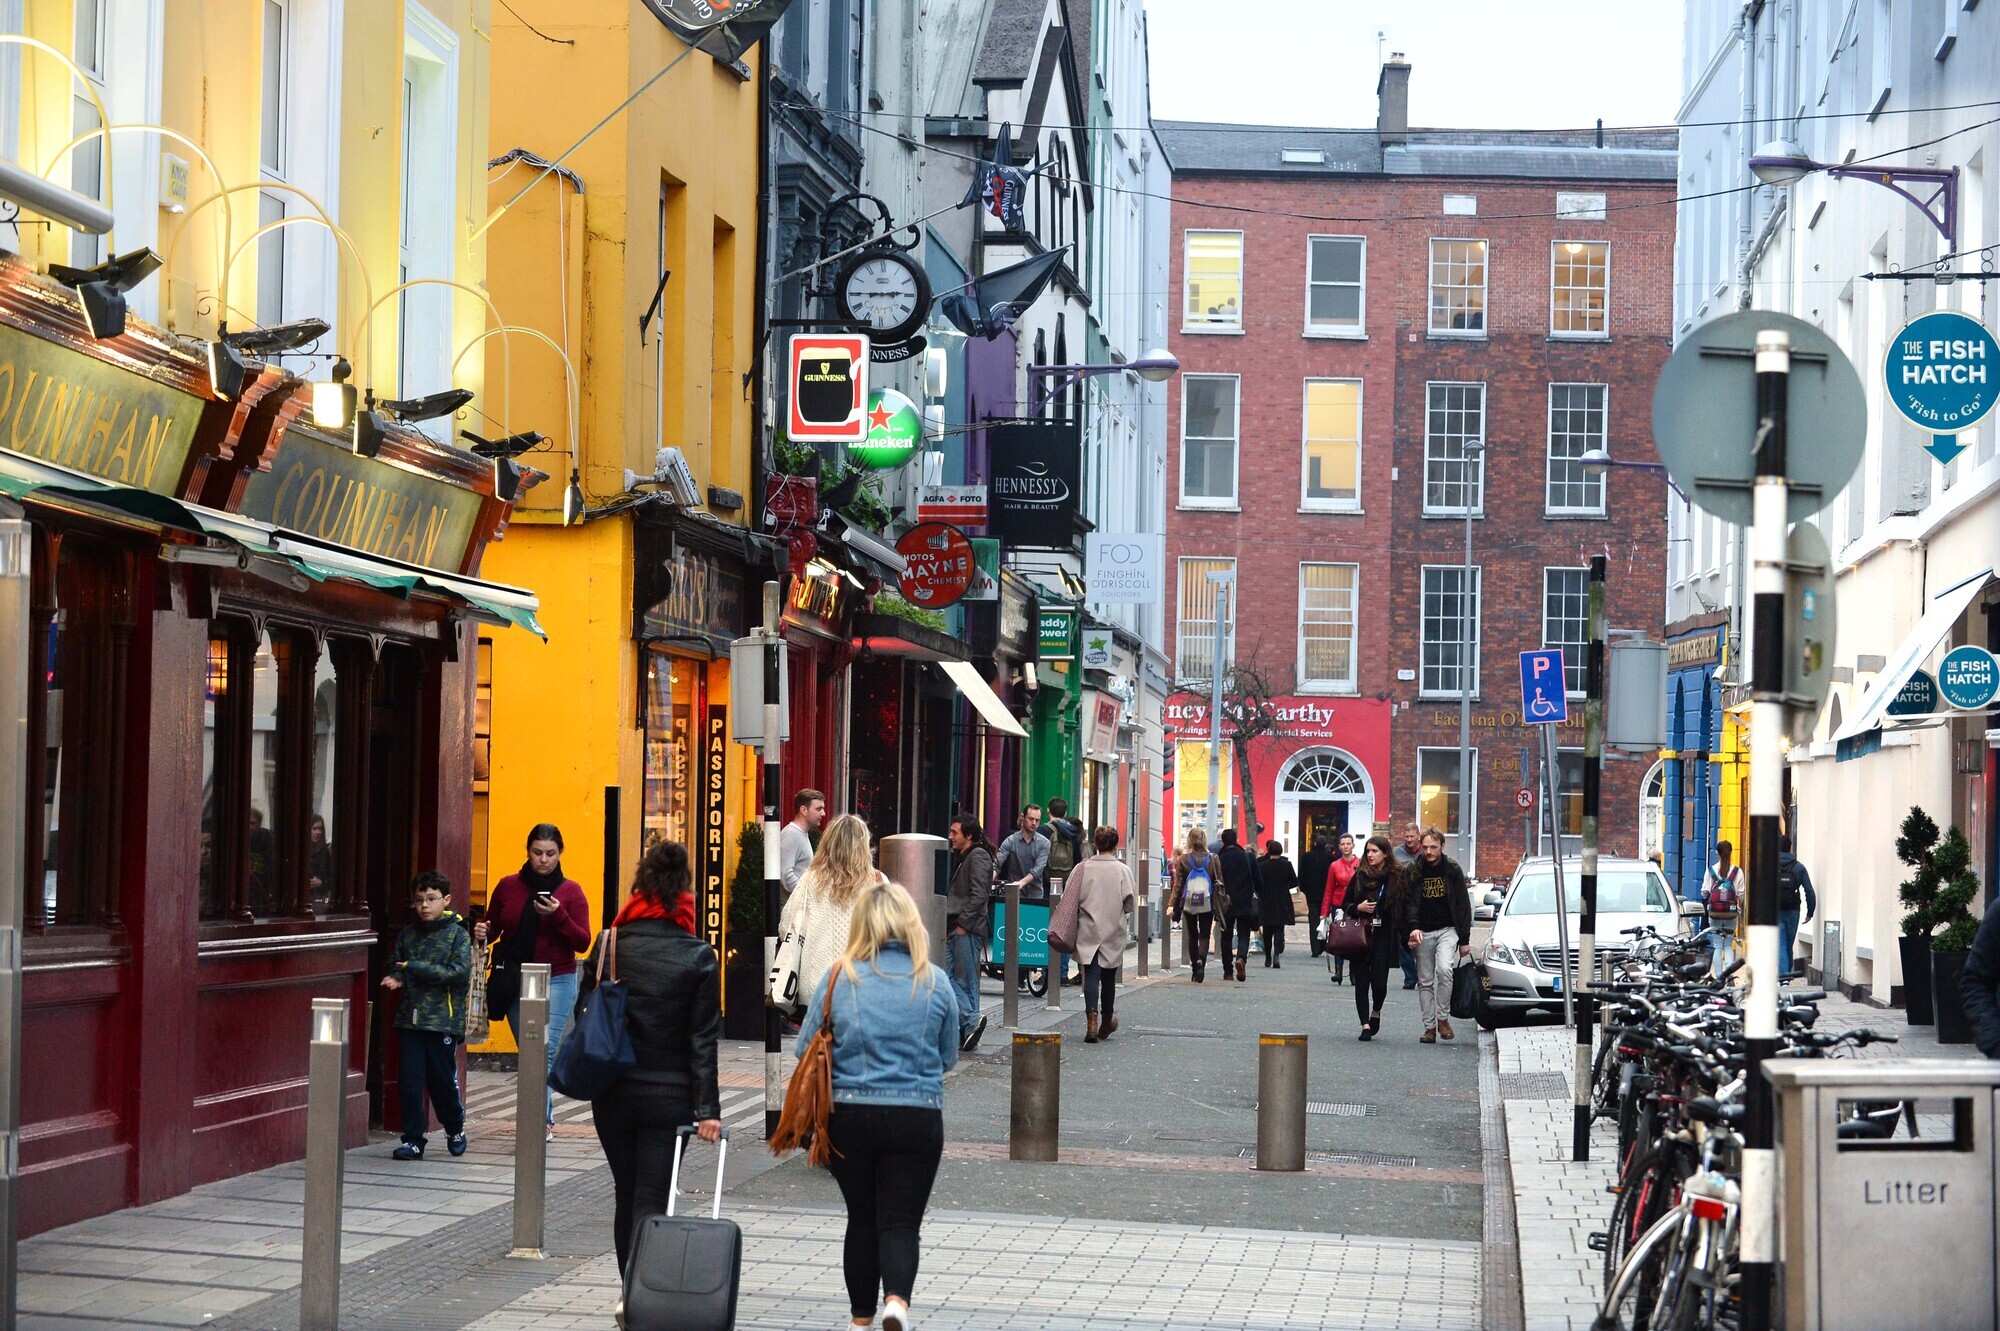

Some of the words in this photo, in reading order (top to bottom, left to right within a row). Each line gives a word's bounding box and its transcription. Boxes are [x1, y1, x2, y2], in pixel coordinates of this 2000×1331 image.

[870, 347, 910, 360] NNESS
[1903, 341, 1923, 354] THE
[1929, 340, 1986, 360] FISH
[804, 374, 847, 382] GUINNESS
[1902, 365, 1987, 385] HATCH
[1943, 411, 1958, 422] to
[995, 477, 1058, 495] HENNESSY
[923, 495, 945, 503] AGFA
[960, 495, 982, 503] FOTO
[272, 460, 448, 567] COUNIHAN
[902, 553, 935, 561] HOTOS
[902, 557, 968, 581] MAYNE
[1097, 568, 1145, 579] FINGHÍN
[927, 577, 967, 585] CHEMIST
[1091, 579, 1151, 589] O'DRISCOLL
[1040, 618, 1067, 629] addy
[1533, 657, 1550, 679] P
[1947, 661, 1958, 669] THE
[1961, 660, 1991, 672] FISH
[1947, 673, 1992, 685] HATCH
[1903, 681, 1930, 691] FISH
[1167, 704, 1206, 724] ney
[1434, 711, 1496, 726] Factna
[1300, 729, 1333, 738] Services
[710, 718, 724, 862] PASSPORT
[1864, 1180, 1949, 1204] Litter
